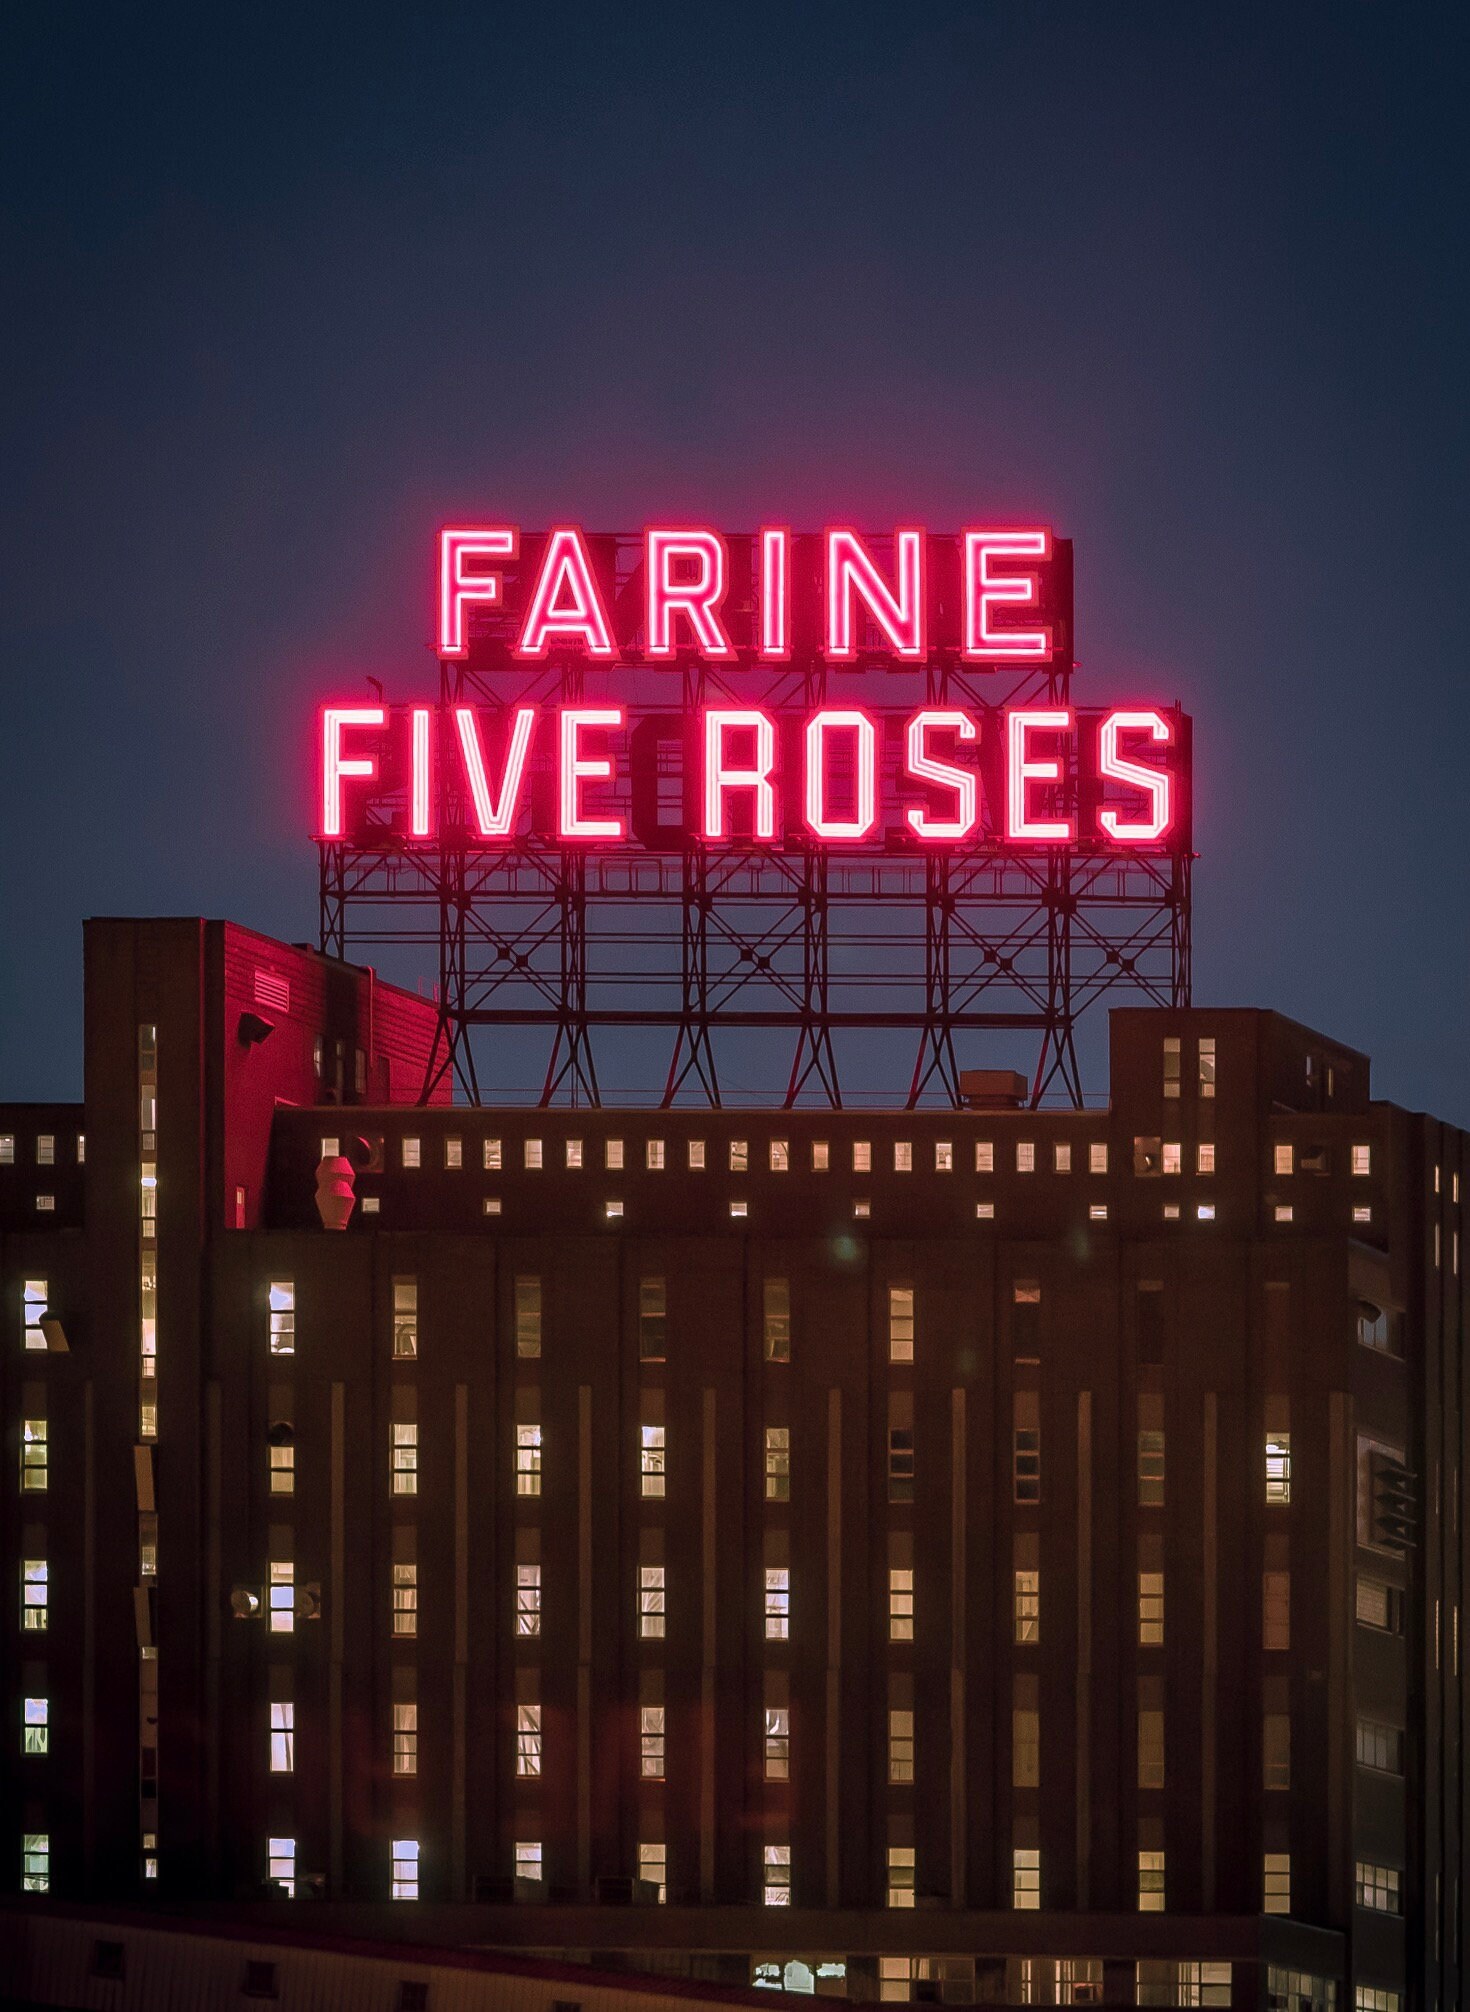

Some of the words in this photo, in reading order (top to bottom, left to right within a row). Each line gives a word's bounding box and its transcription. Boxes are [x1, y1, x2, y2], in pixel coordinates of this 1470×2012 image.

[437, 526, 1053, 662] FARINE
[318, 703, 626, 841] FIVE
[700, 704, 1175, 844] ROSES
